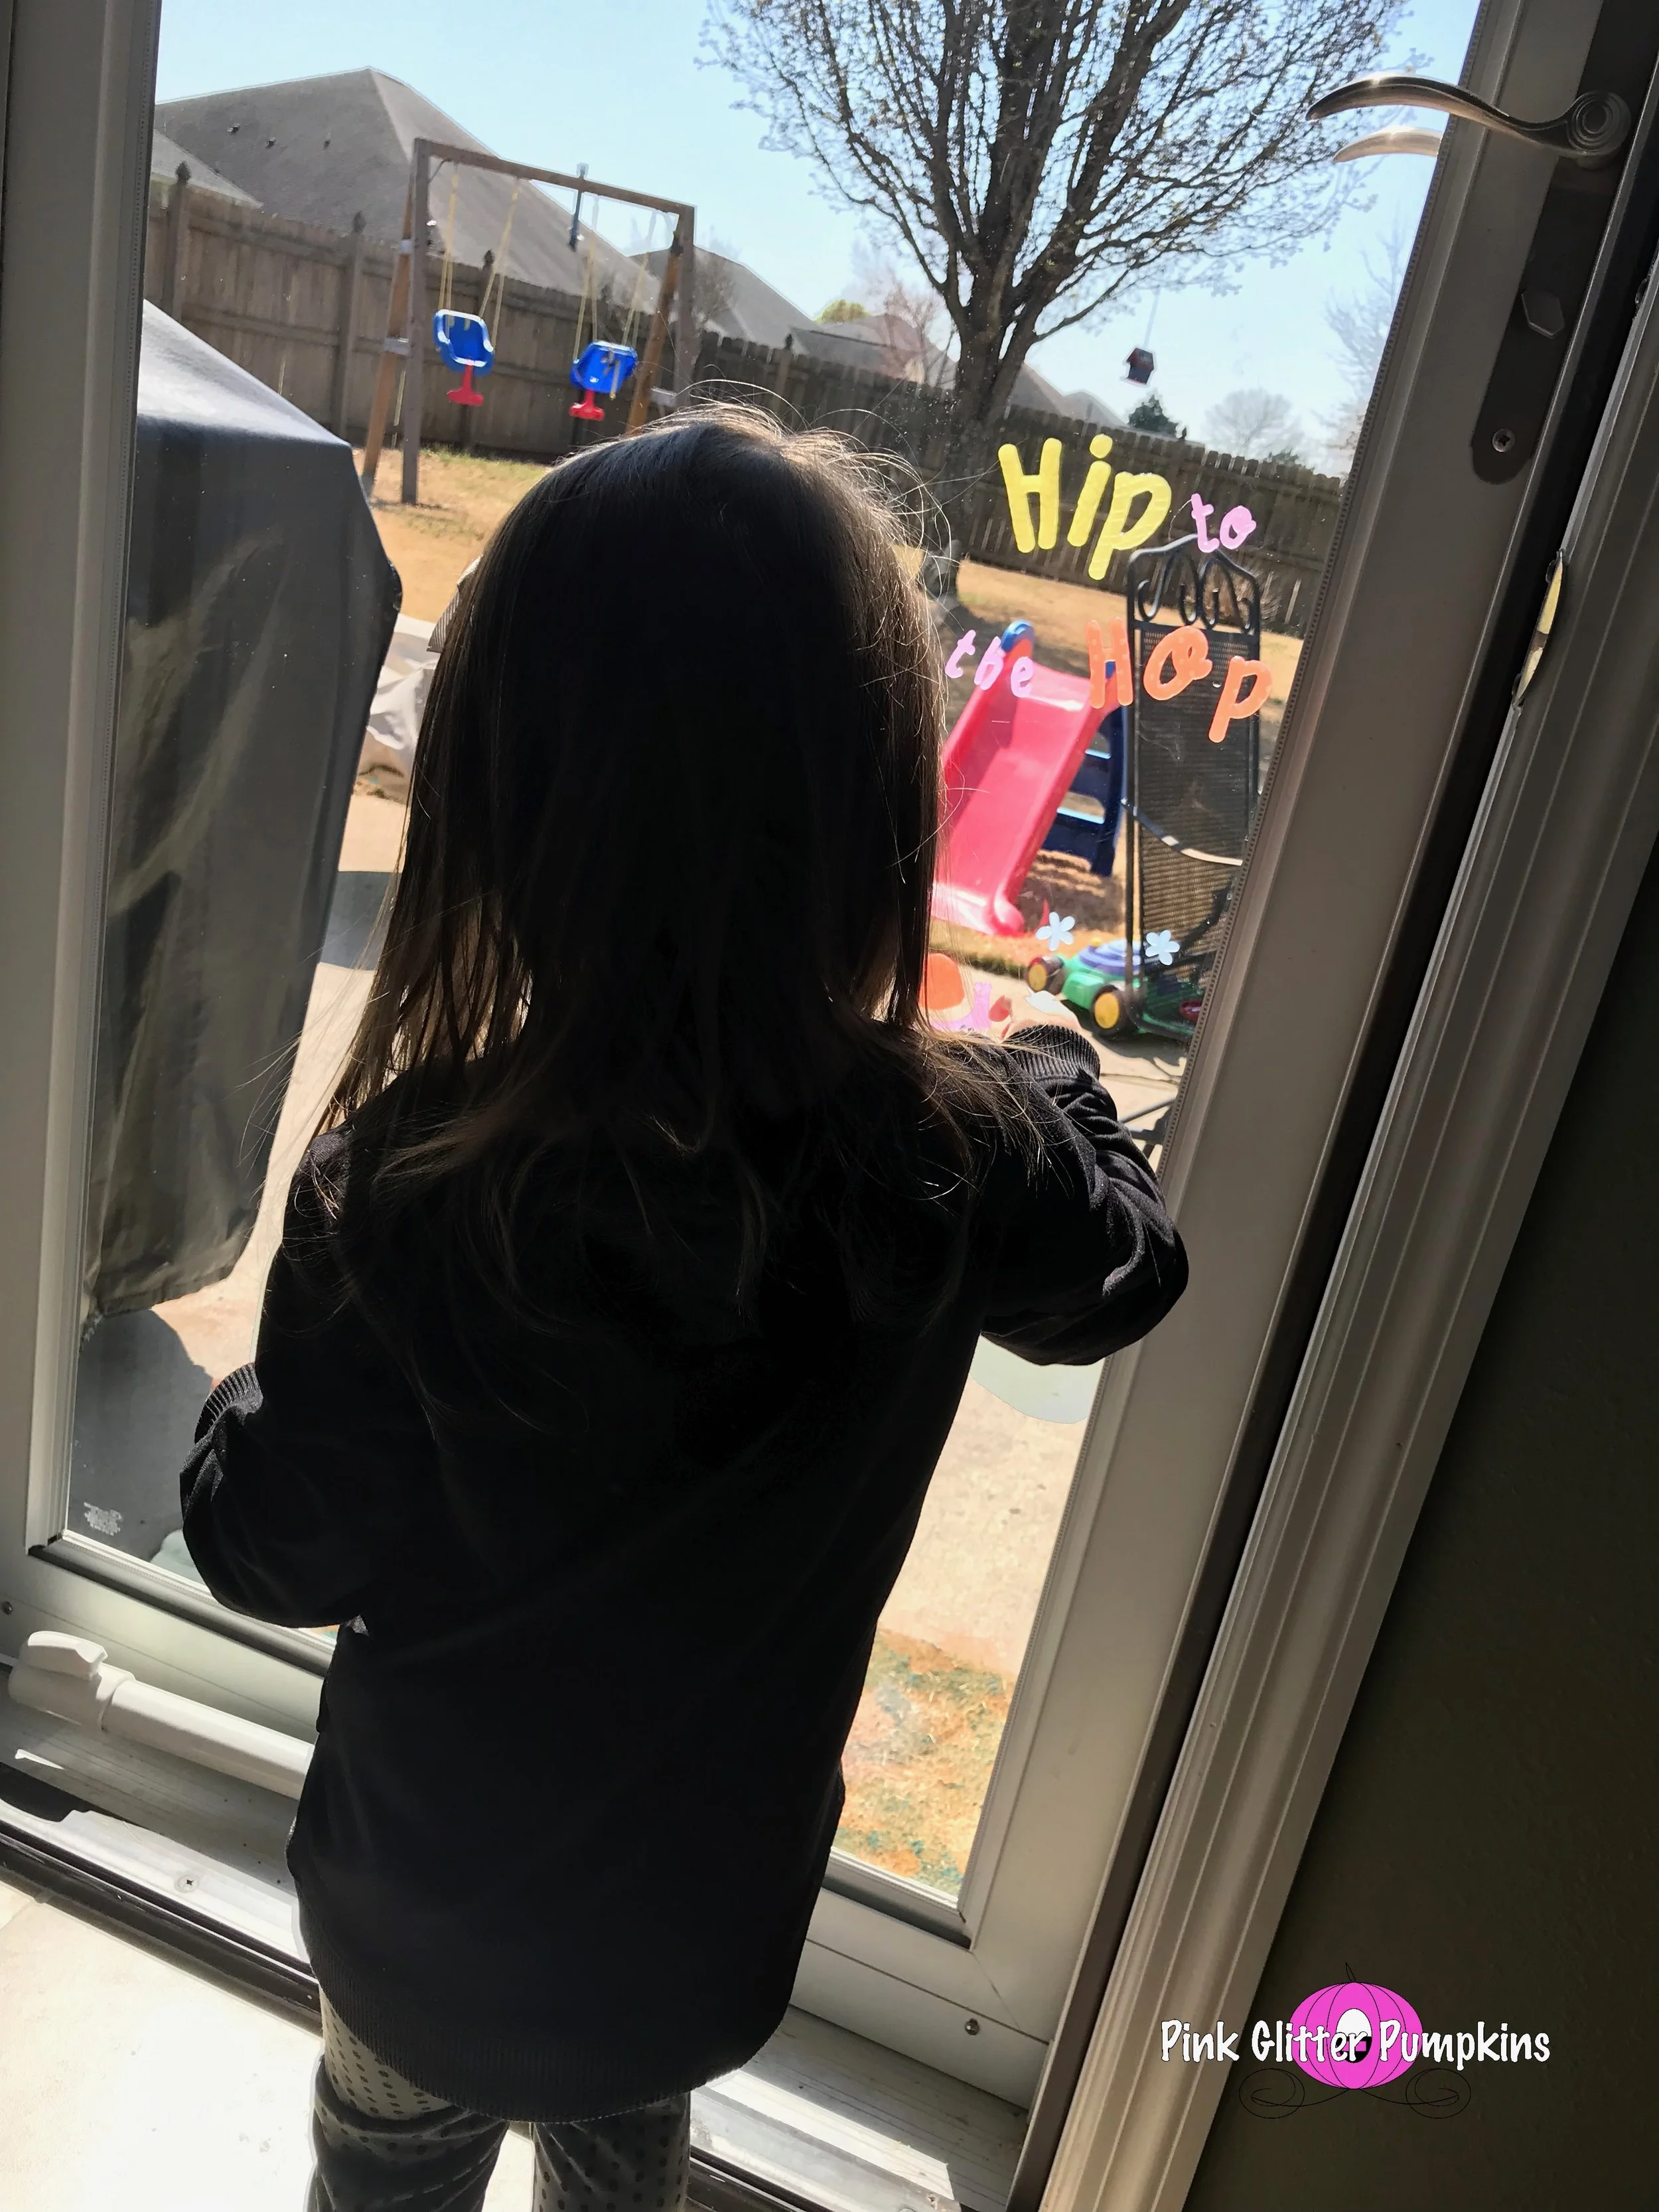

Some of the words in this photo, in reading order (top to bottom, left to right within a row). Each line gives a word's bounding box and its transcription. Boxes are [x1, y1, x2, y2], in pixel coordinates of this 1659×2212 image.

[998, 435, 1172, 580] Hip
[1191, 493, 1256, 553] to
[945, 629, 1035, 698] the
[1086, 617, 1272, 743] Hop
